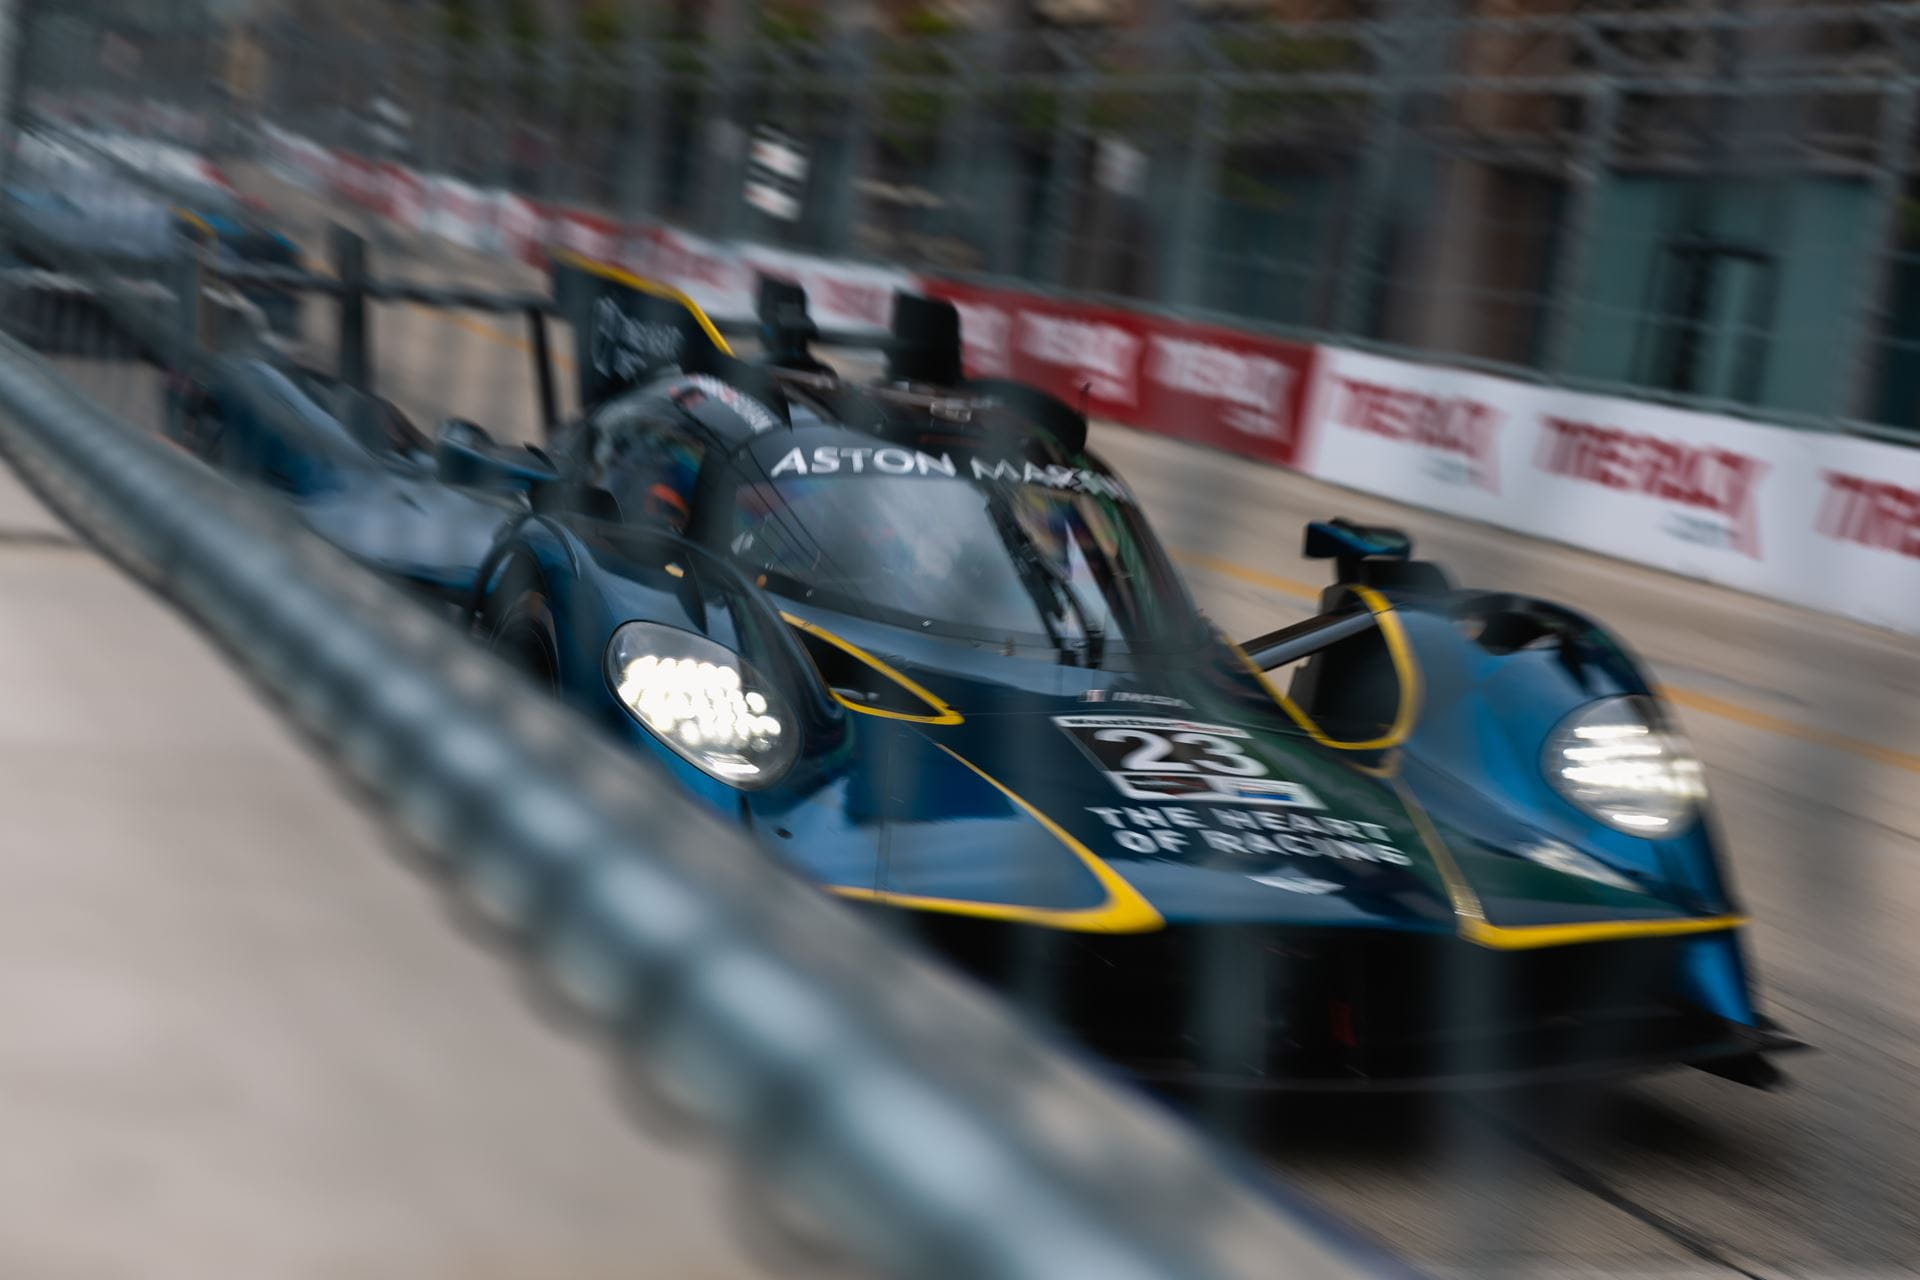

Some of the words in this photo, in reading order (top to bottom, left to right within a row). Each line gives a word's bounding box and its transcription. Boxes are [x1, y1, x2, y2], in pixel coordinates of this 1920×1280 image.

[771, 446, 956, 477] ASTON
[1093, 728, 1268, 777] 23
[1084, 806, 1208, 829] THE
[1209, 807, 1393, 843] HEART
[1112, 829, 1190, 854] OF
[1198, 829, 1414, 867] RACING
